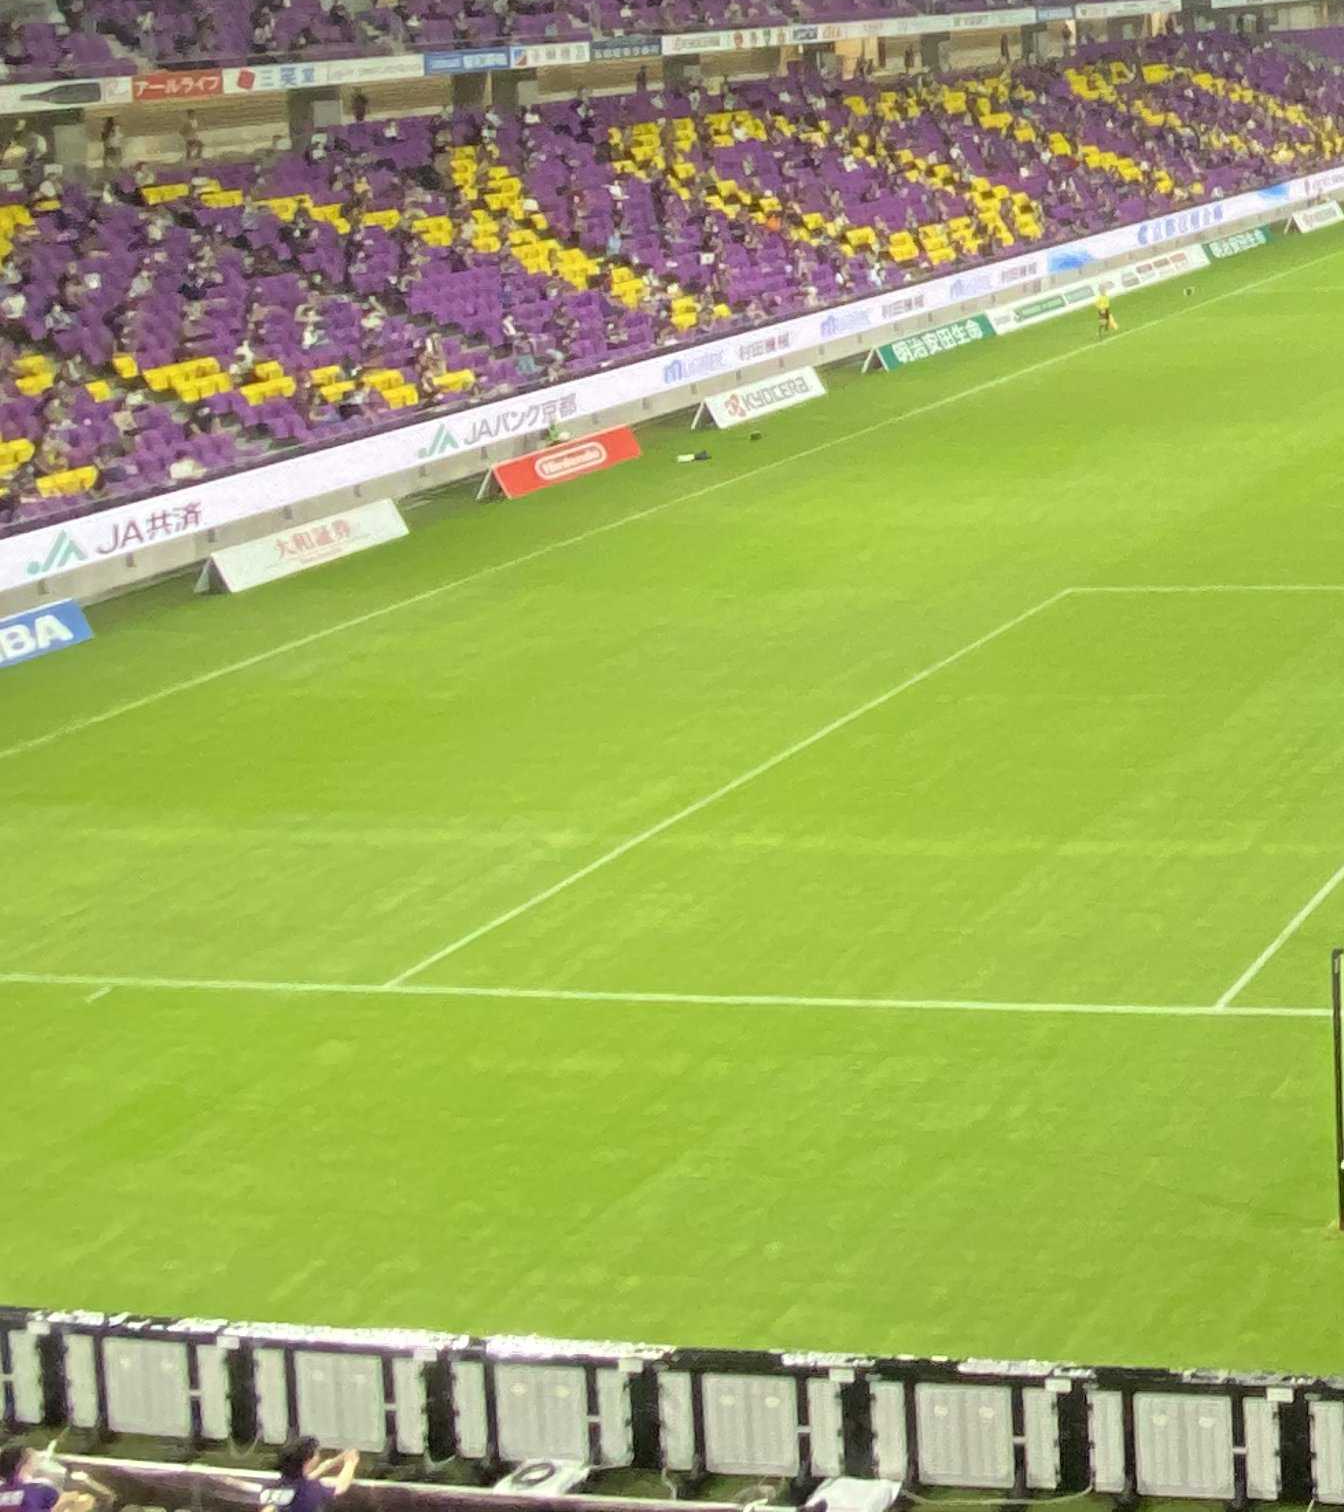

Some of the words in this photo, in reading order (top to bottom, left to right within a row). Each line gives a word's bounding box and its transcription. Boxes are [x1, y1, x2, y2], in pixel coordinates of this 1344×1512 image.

[135, 75, 220, 95] アールライフ
[891, 319, 984, 363] 明治安田生命
[743, 375, 810, 410] KYOCERA
[464, 392, 577, 445] JAバンク京都
[542, 446, 600, 475] Nintendo
[96, 503, 203, 555] JA共済
[0, 614, 75, 662] BA
